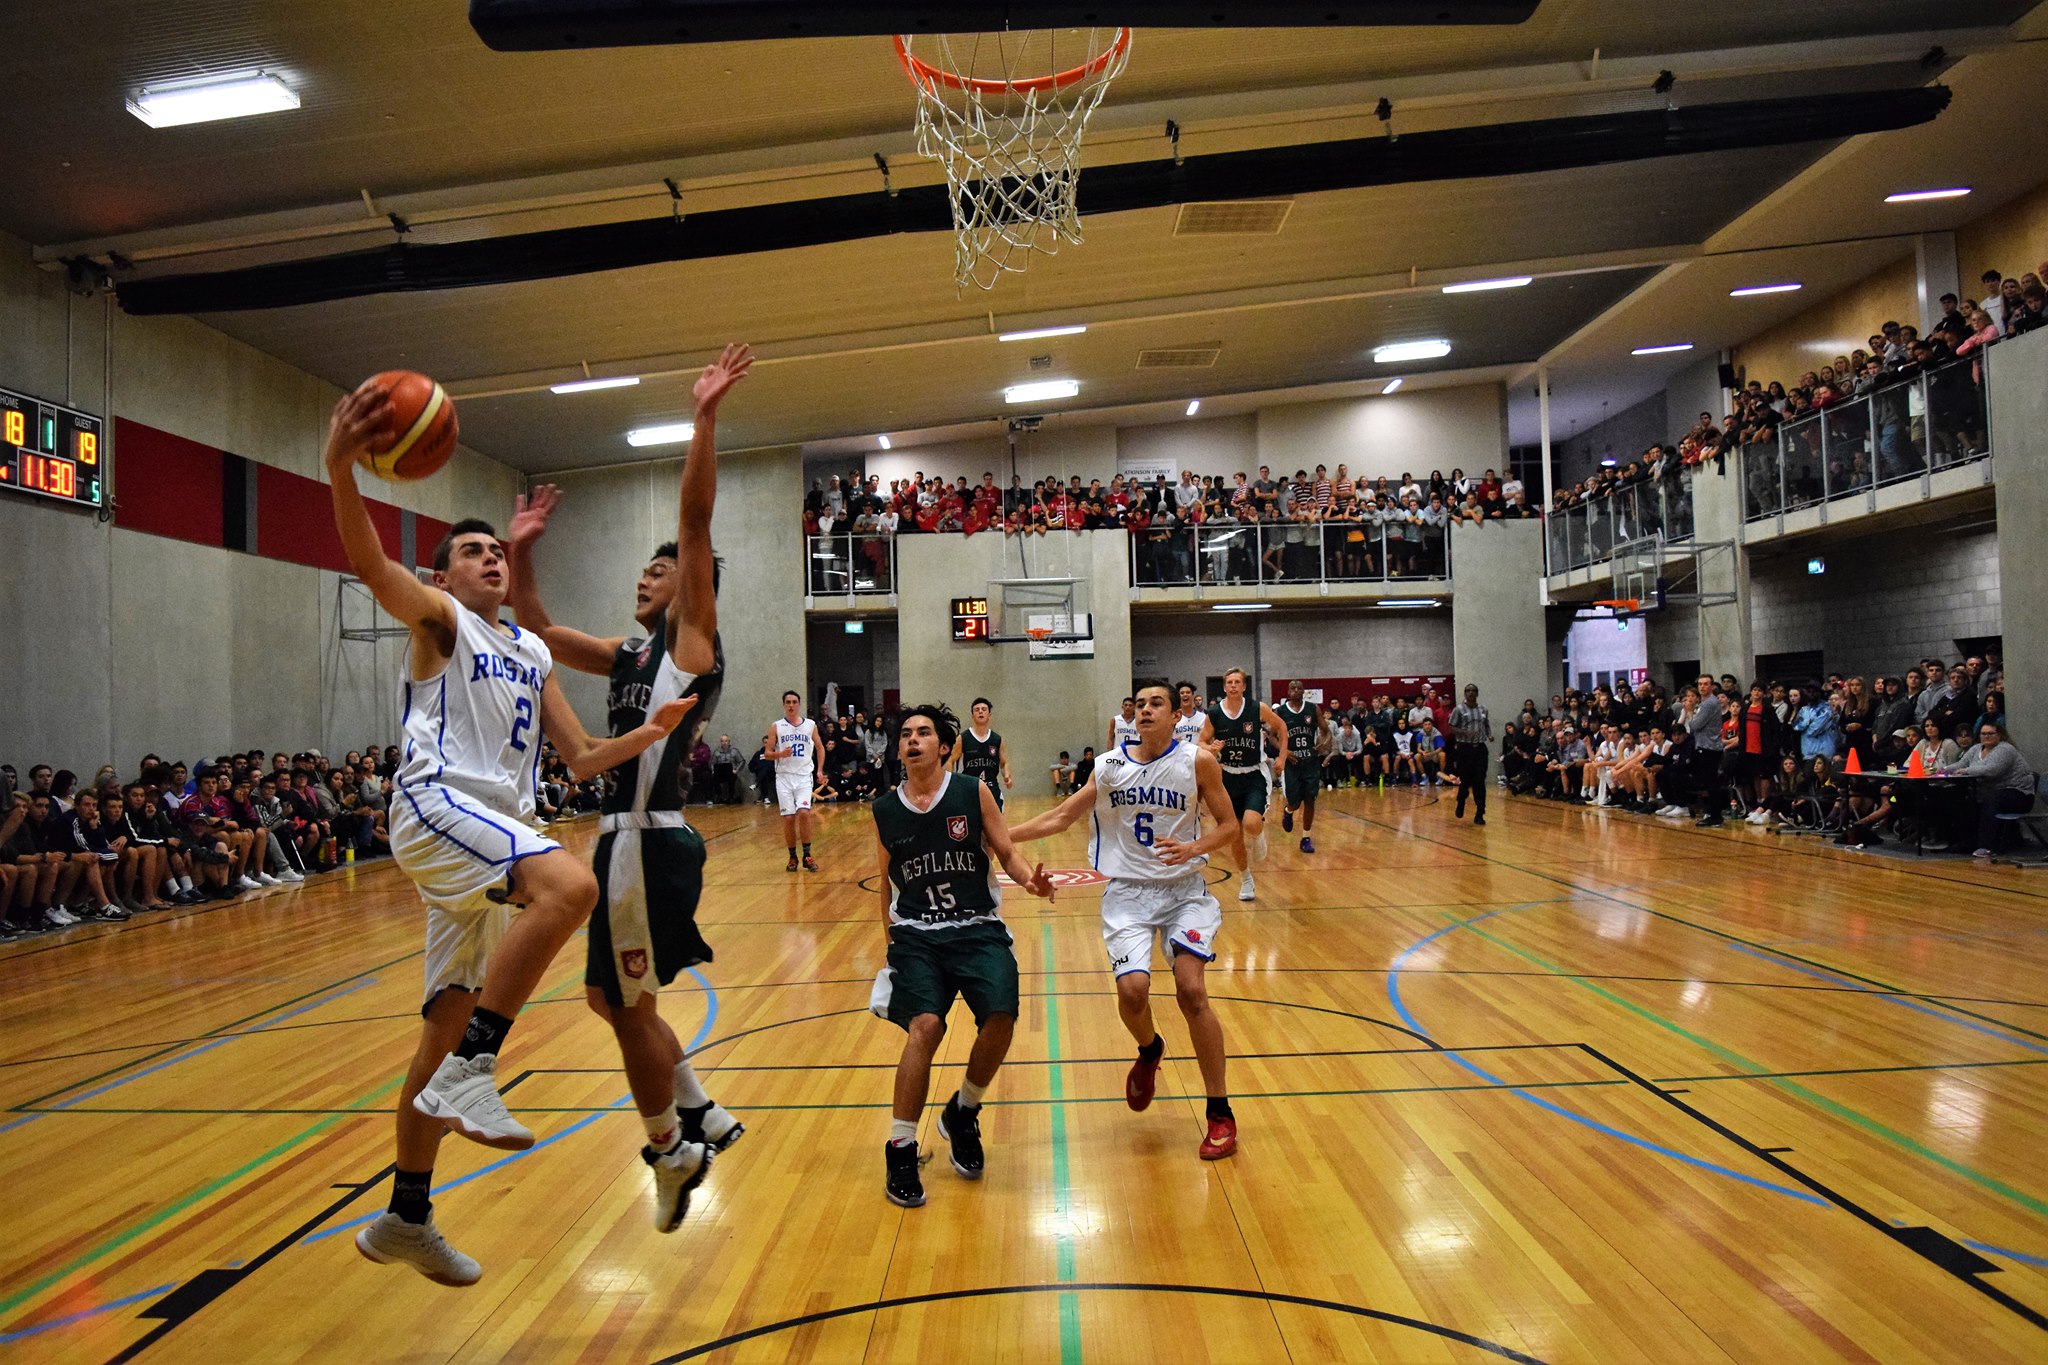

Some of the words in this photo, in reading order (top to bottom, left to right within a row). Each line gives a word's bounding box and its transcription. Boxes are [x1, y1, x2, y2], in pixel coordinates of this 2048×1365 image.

[0, 395, 19, 409] HOME
[6, 410, 24, 446] 18
[75, 416, 92, 430] GUEST
[79, 432, 97, 465] 19
[91, 480, 100, 503] 5
[965, 619, 986, 637] 21
[510, 696, 533, 753] 2
[791, 743, 805, 757] 42
[1185, 734, 1193, 742] 7
[1295, 737, 1308, 748] 66
[1108, 786, 1187, 812] ROSMINI
[1134, 812, 1155, 848] 6
[900, 851, 977, 885] WESTLAKE
[925, 882, 957, 911] 15
